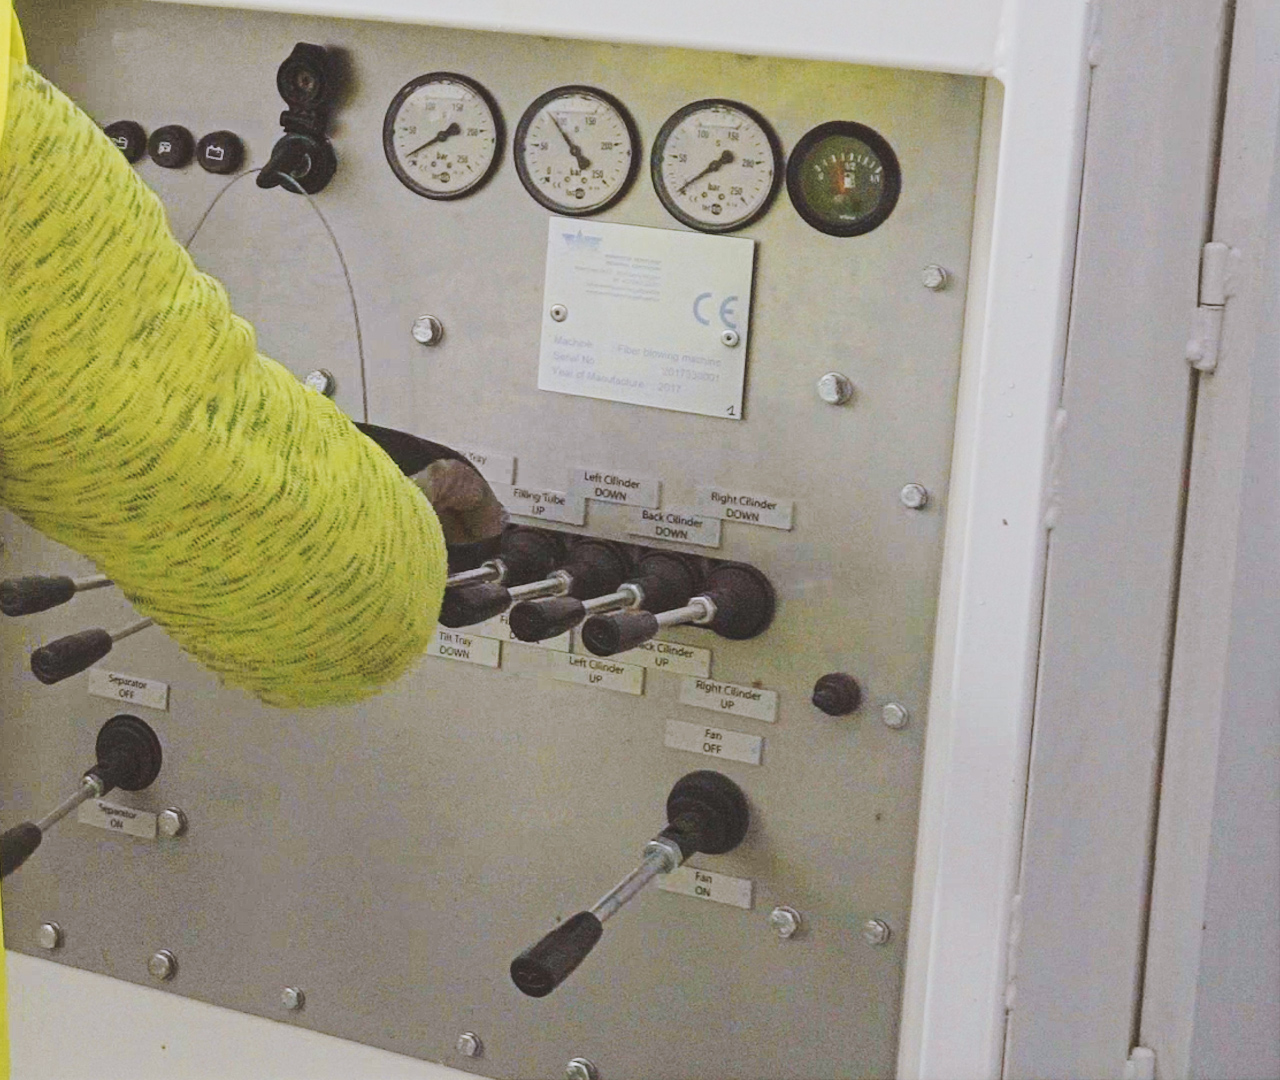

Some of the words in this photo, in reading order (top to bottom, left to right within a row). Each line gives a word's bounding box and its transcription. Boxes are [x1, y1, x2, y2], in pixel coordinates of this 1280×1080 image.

[693, 292, 739, 329] CE
[553, 351, 580, 364] Serial
[617, 344, 640, 356] Fiber
[643, 348, 679, 363] blowing
[682, 354, 722, 369] machine
[552, 366, 574, 379] Year
[576, 369, 585, 380] of
[586, 371, 645, 389] Manufacture
[658, 381, 682, 393] 2017
[726, 405, 736, 416] 1
[584, 471, 603, 484] Left
[604, 474, 641, 490] Cilinder
[513, 488, 541, 502] Filling
[542, 492, 566, 506] Tube
[595, 487, 627, 502] DOWN
[711, 491, 738, 506] Right
[740, 496, 778, 511] Cilinder
[531, 505, 545, 515] UP
[642, 510, 664, 522] Back
[726, 507, 760, 522] DOWN
[655, 526, 689, 540] DOWN
[440, 631, 453, 643] Tilt
[455, 634, 472, 647] Tray
[440, 645, 471, 659] DOWN
[657, 643, 695, 659] Cilinder
[569, 656, 587, 668] Left
[588, 659, 625, 675] Cilinder
[655, 658, 669, 667] UP
[108, 673, 148, 689] Separator
[588, 673, 603, 684] UP
[119, 688, 136, 699] OFF
[696, 680, 722, 695] Right
[724, 685, 763, 701] Cilinder
[720, 699, 735, 709] UP
[704, 729, 723, 740] Fan
[703, 742, 723, 754] OFF
[98, 802, 138, 819] Separator
[110, 818, 124, 829] ON
[695, 871, 713, 884] Fan
[694, 885, 711, 897] ON
